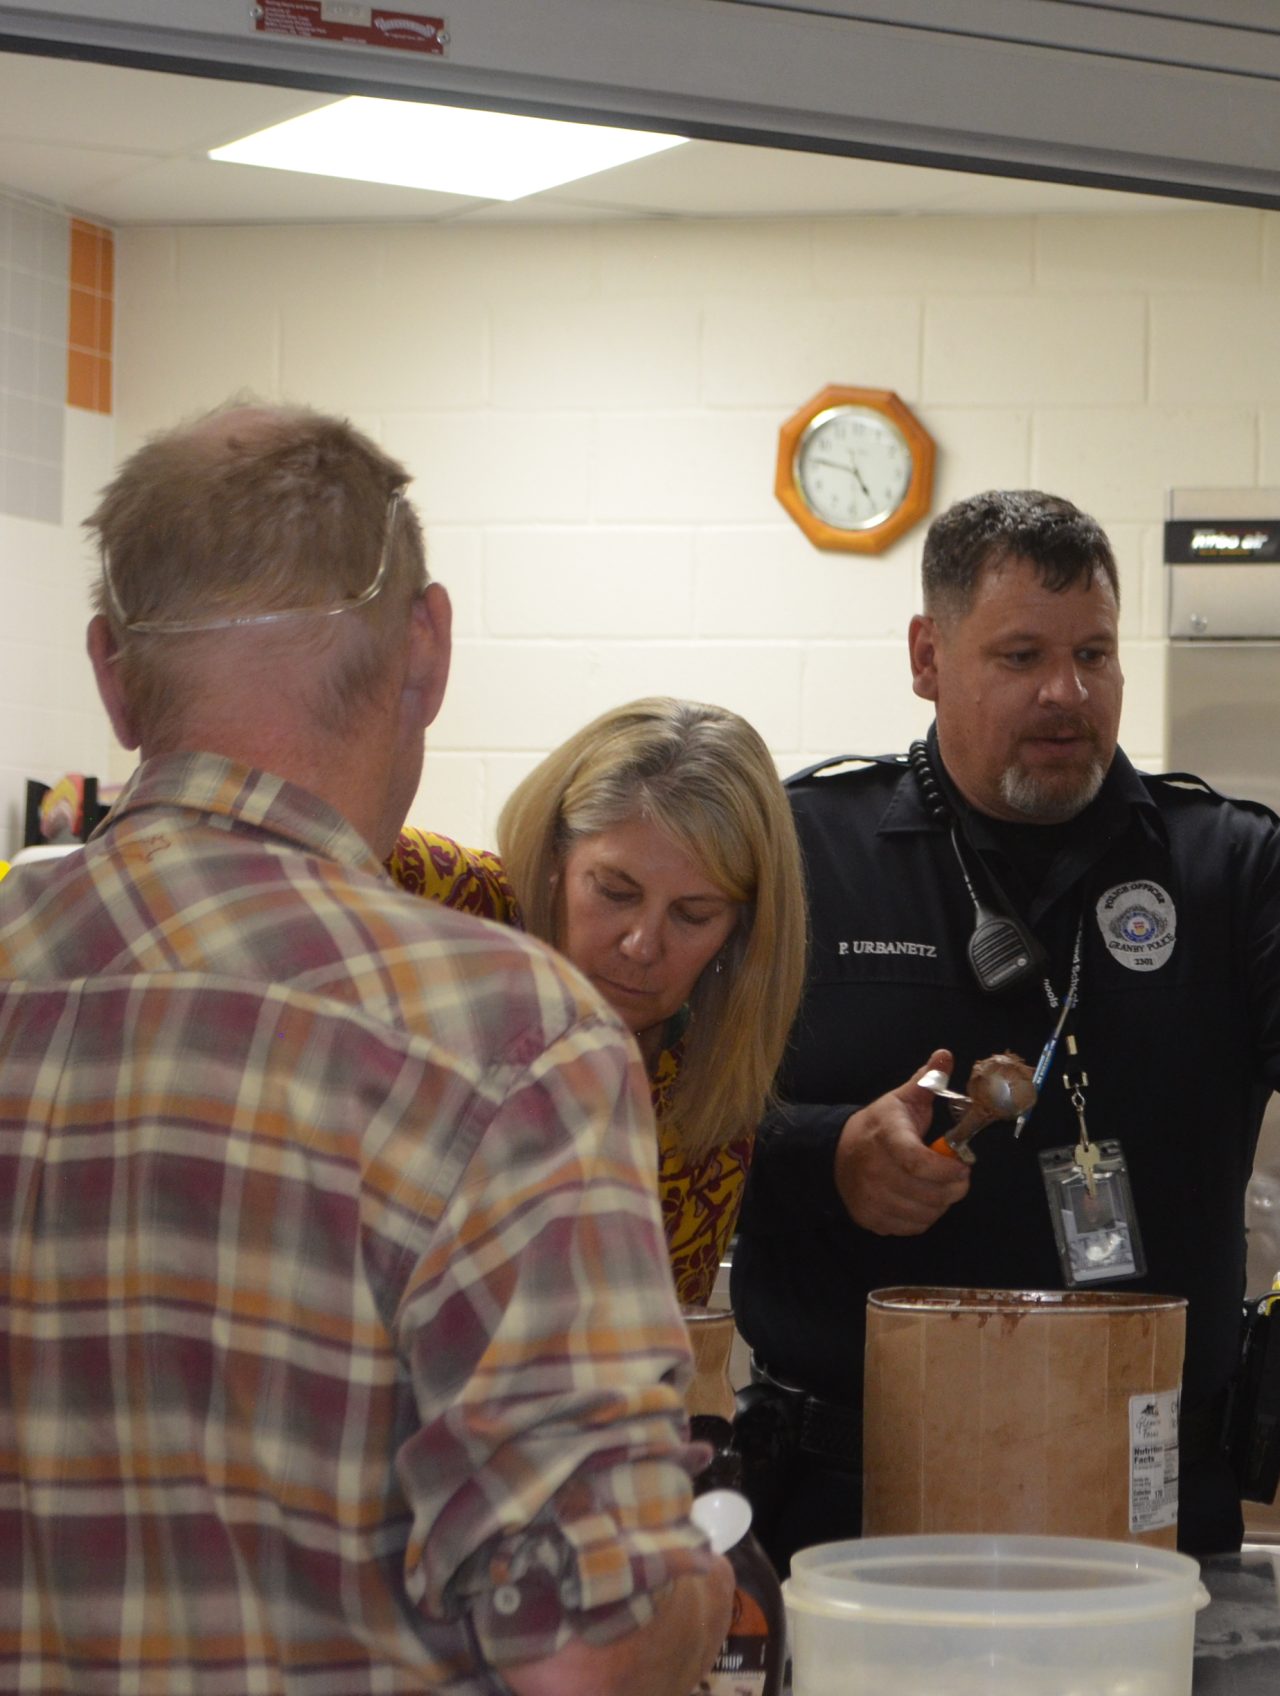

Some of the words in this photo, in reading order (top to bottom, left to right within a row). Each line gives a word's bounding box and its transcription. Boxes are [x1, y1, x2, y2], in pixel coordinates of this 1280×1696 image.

[1105, 884, 1129, 909] POLICE
[1130, 883, 1165, 904] OFFICER
[838, 942, 849, 955] P.
[853, 941, 937, 958] URBANETZ
[1109, 941, 1144, 953] GRANBY
[1147, 933, 1176, 951] POLICE
[1134, 1455, 1155, 1464] Facts
